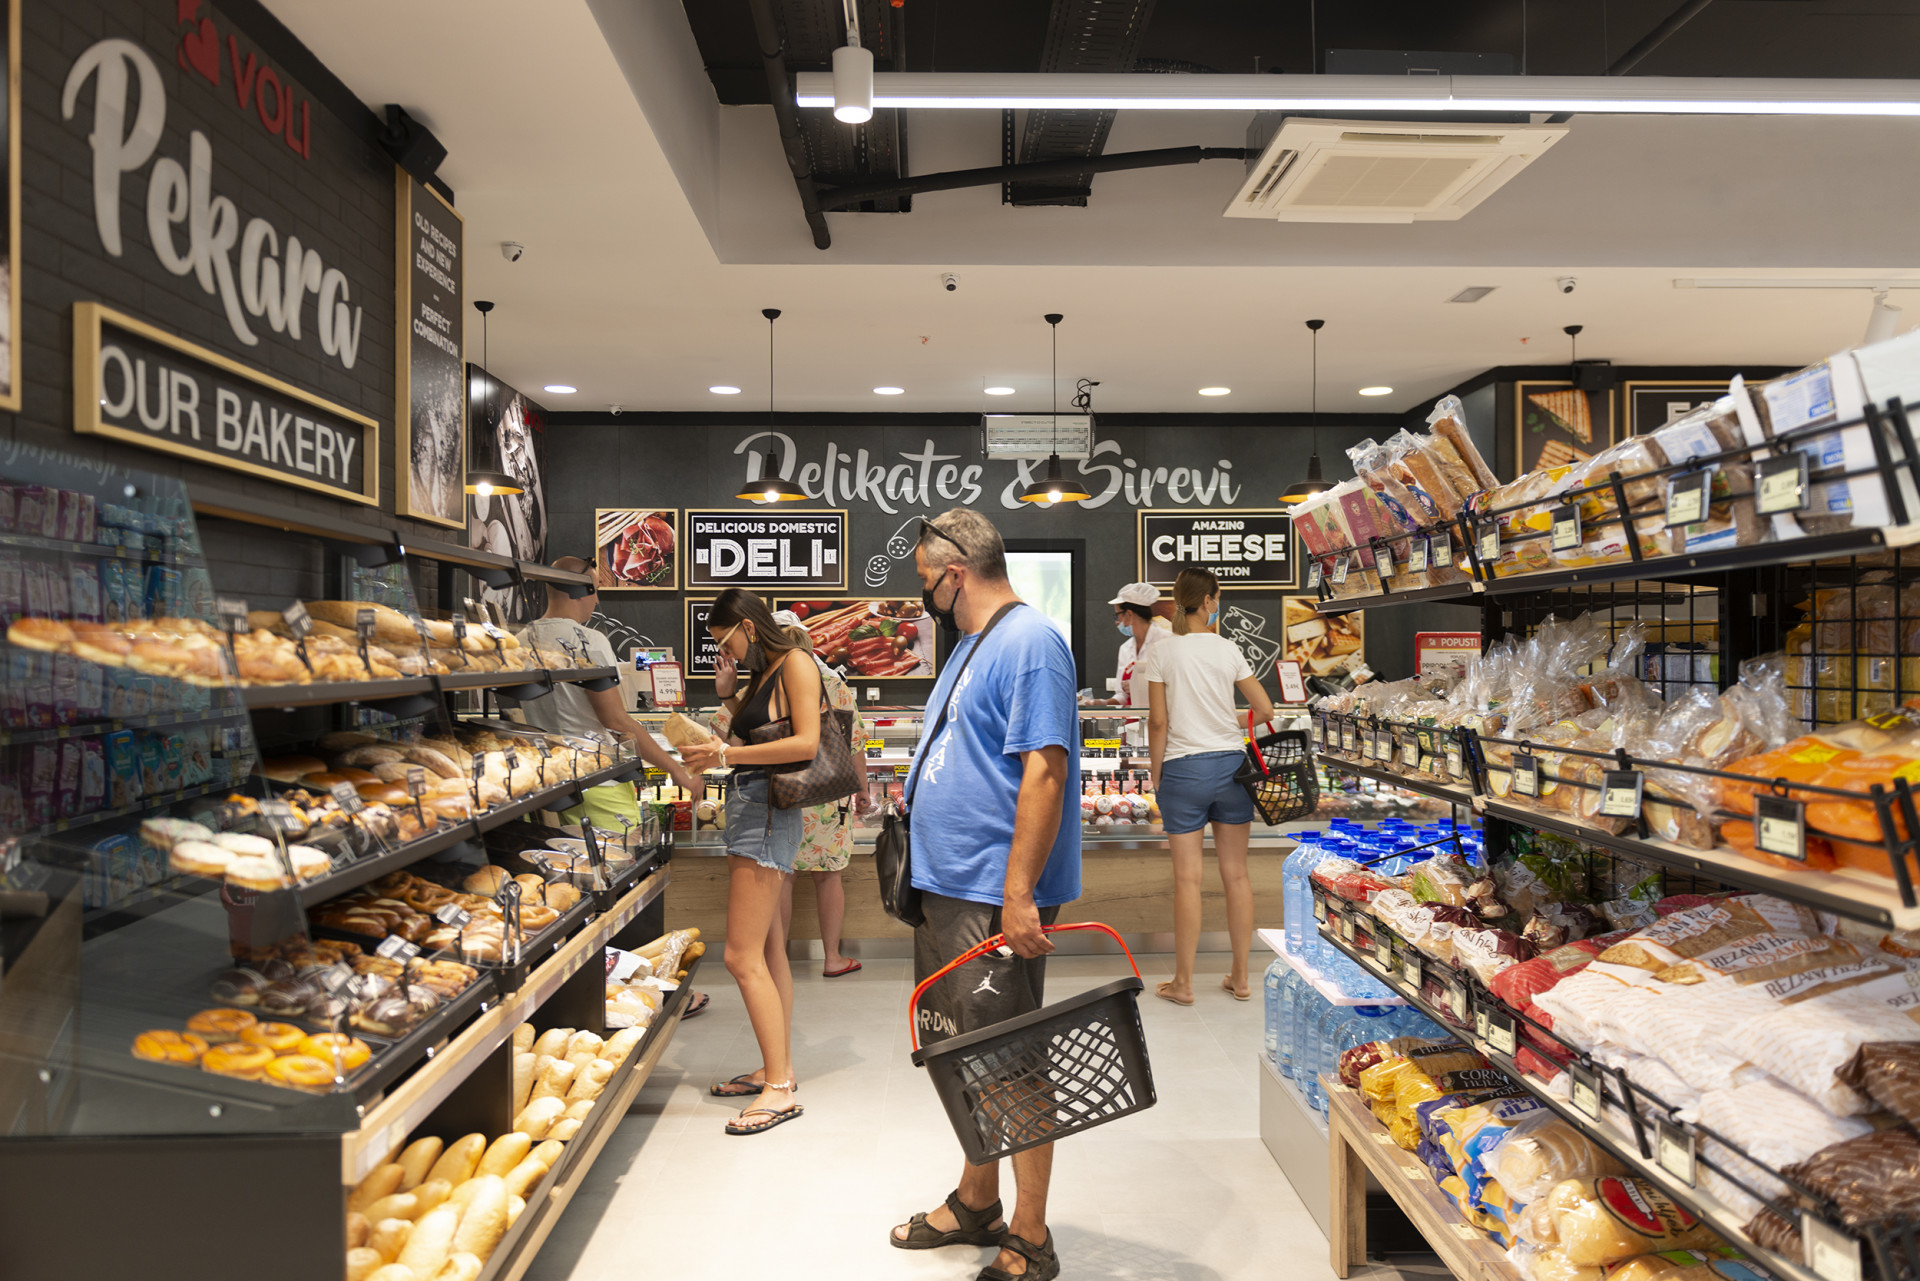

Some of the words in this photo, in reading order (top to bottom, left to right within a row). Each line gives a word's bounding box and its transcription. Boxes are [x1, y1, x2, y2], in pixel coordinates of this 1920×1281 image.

[229, 35, 309, 159] VOLI
[62, 38, 362, 369] Pekara
[415, 212, 429, 234] OLD
[430, 224, 457, 258] RECIPES
[420, 236, 435, 259] AND
[436, 248, 452, 272] NEW
[416, 252, 456, 295] EXPERIENCE
[421, 302, 450, 334] PERFECT
[413, 318, 458, 358] COMBINATION
[101, 345, 201, 440] OUR
[216, 387, 356, 484] BAKERY
[1077, 439, 1242, 510] Sirevi
[696, 522, 766, 535] DELICIOUS
[769, 522, 837, 535] DOMESTIC
[1192, 521, 1245, 531] AMAZING
[710, 538, 823, 577] DELI
[1151, 534, 1286, 562] CHEESE
[1441, 637, 1478, 647] POPUST!
[1459, 1070, 1503, 1081] CORN
